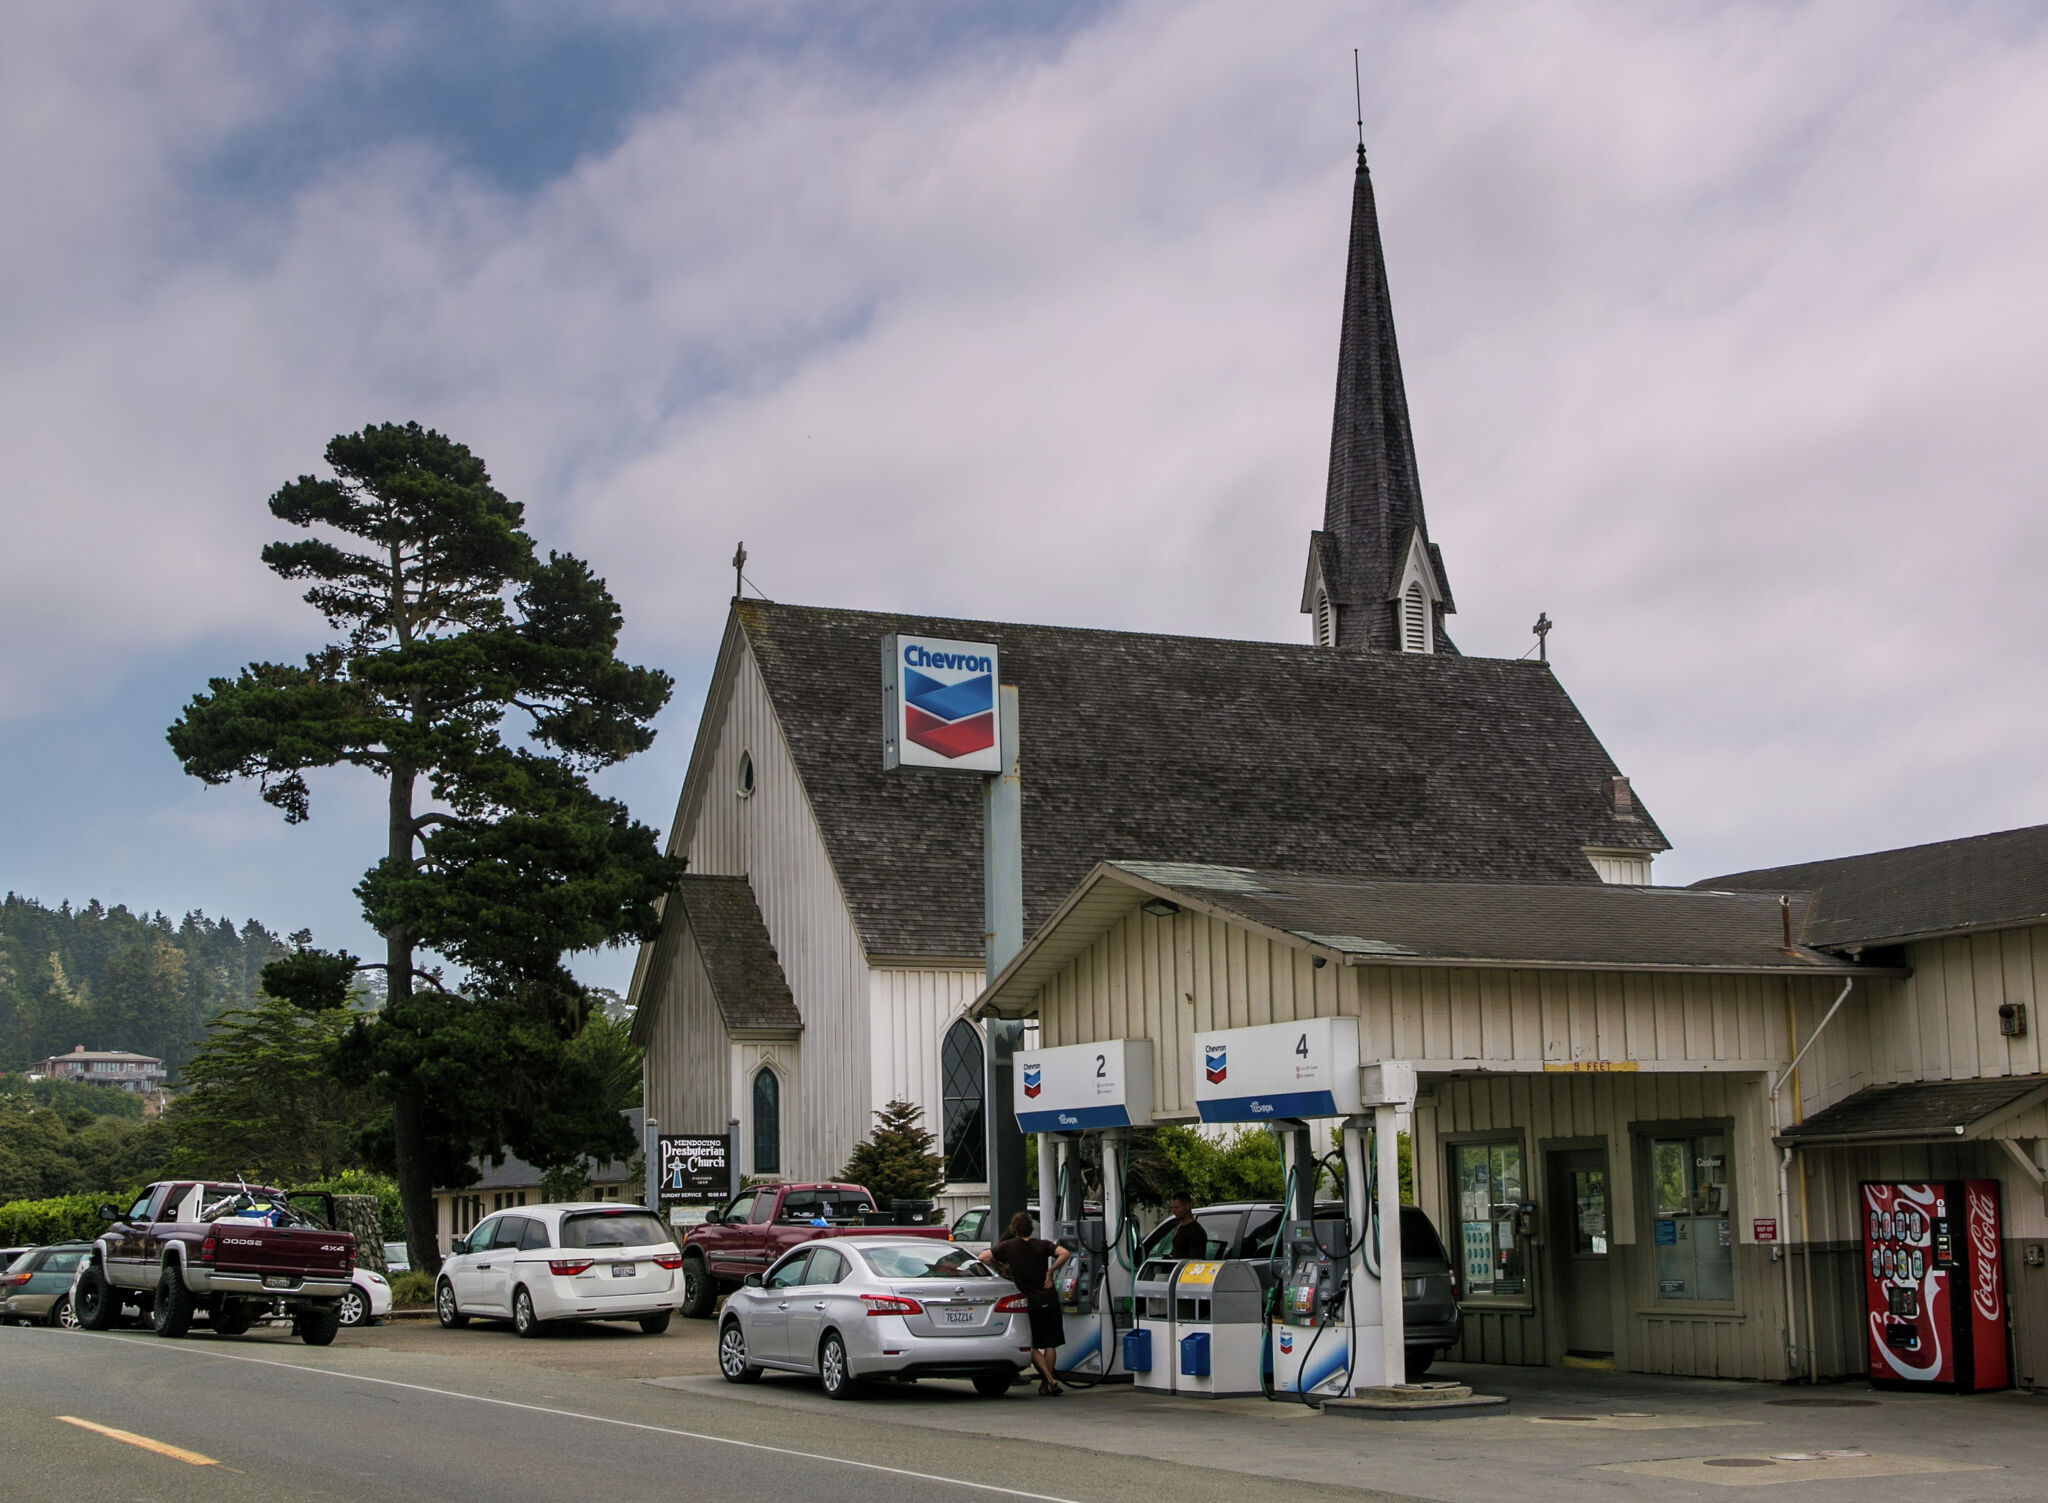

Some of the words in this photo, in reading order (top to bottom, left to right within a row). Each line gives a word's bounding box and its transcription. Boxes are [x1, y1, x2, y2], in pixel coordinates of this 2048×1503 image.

[904, 644, 992, 672] Chevron
[1205, 1044, 1226, 1053] Chevron
[1296, 1033, 1308, 1059] 4
[1023, 1063, 1041, 1071] Chevron
[1096, 1054, 1106, 1078] 2
[1587, 1062, 1611, 1071] FEET
[674, 1139, 721, 1147] MENDOCINO
[687, 1156, 725, 1173] Church
[1696, 1158, 1722, 1167] Cashier
[222, 1238, 262, 1246] DODGE
[1969, 1186, 2000, 1321] Coca-Cola
